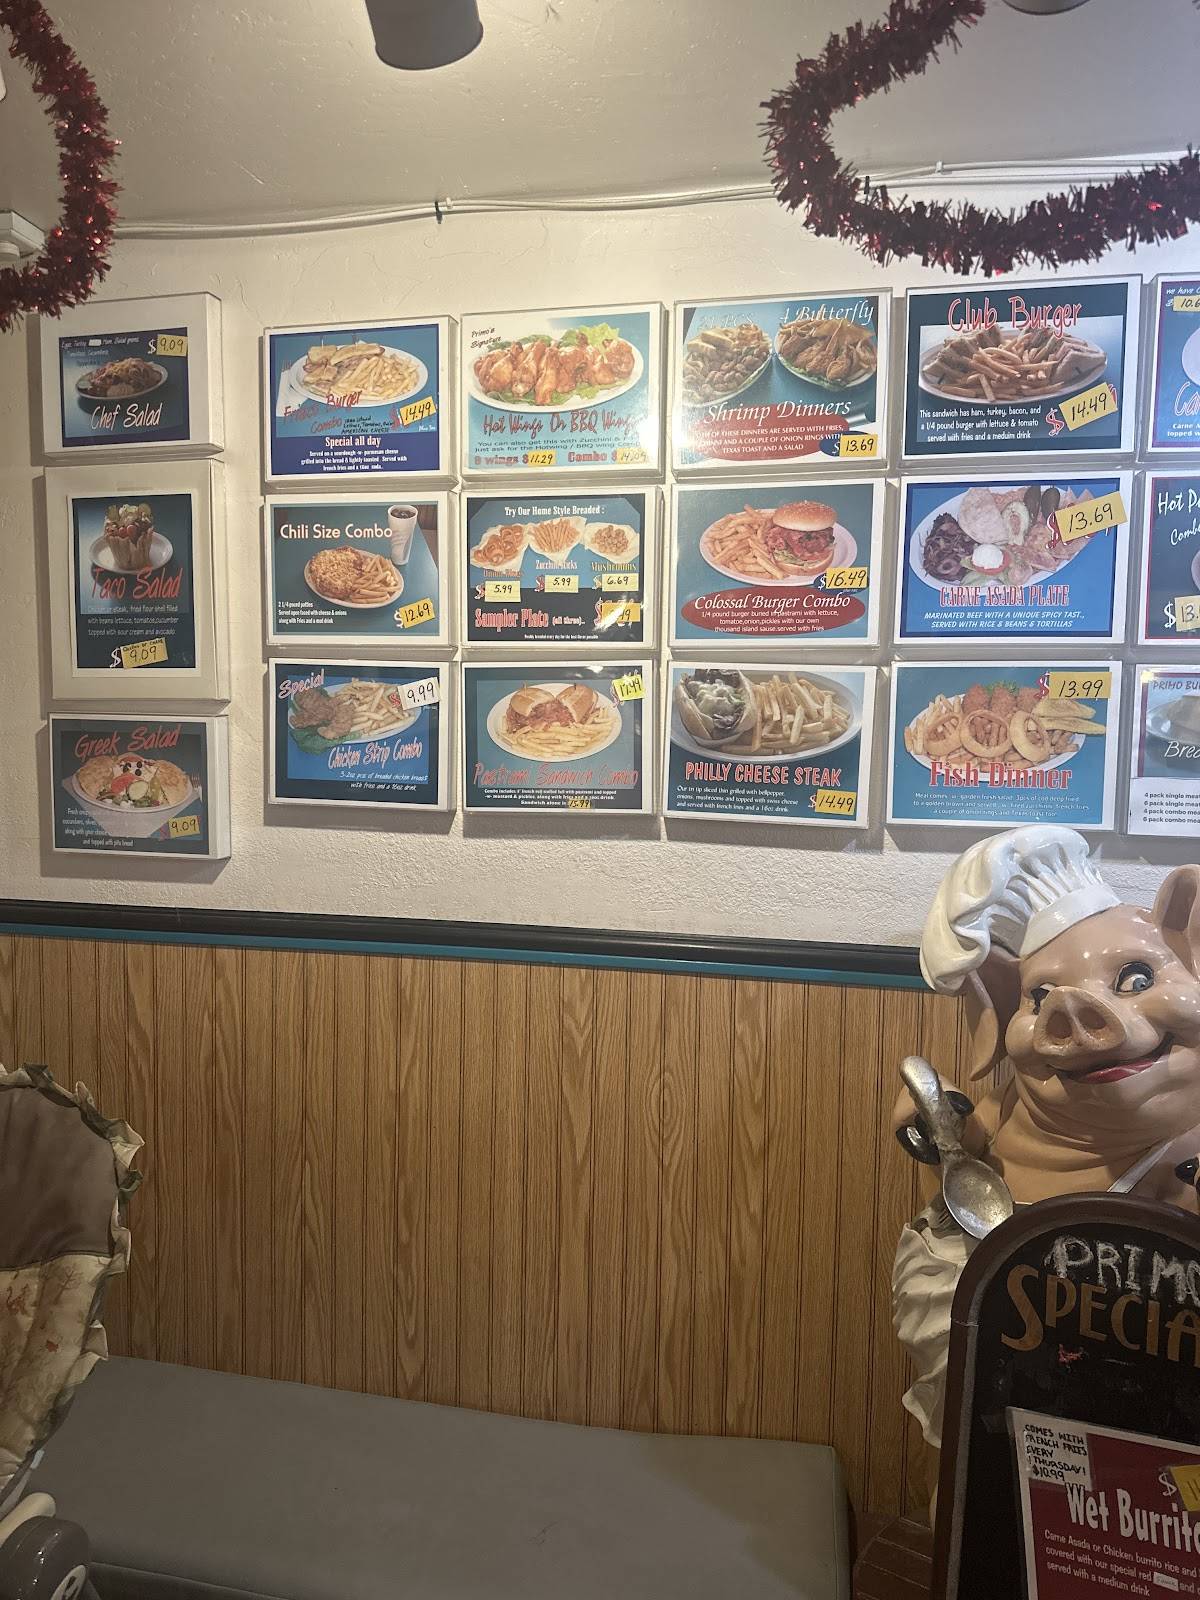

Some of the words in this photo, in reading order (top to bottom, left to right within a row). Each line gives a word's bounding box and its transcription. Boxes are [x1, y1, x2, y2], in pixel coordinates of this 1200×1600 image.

[796, 300, 874, 327] Butterfly
[948, 296, 998, 332] Club
[1008, 295, 1083, 339] Burger
[470, 336, 501, 348] Signature
[471, 328, 495, 338] Primo's
[161, 338, 184, 353] 9.09
[325, 390, 362, 411] Burger
[1071, 392, 1107, 421] 14.49
[91, 404, 121, 431] Chef
[123, 402, 163, 428] Salad
[405, 402, 431, 421] 14.49
[704, 401, 771, 426] Shrimp
[777, 401, 852, 418] Dinners
[920, 410, 931, 418] This
[932, 409, 959, 417] sandwich
[960, 408, 969, 416] has
[971, 408, 985, 416] ham,
[987, 407, 1006, 417] turkey,
[1009, 406, 1028, 415] bacon,
[1030, 405, 1041, 414] and
[483, 414, 506, 436] Hot
[509, 412, 543, 439] Wings
[551, 412, 567, 433] Or
[570, 410, 598, 433] BBQ
[937, 421, 954, 431] pound
[956, 421, 974, 431] burger
[976, 420, 987, 428] with
[989, 420, 1009, 428] lettuce
[1011, 419, 1016, 427] &
[325, 436, 353, 449] Special
[355, 436, 365, 446] all
[367, 436, 381, 448] day
[845, 438, 874, 452] 13.69
[928, 434, 946, 442] served
[948, 433, 959, 441] with
[961, 432, 974, 441] fries
[975, 432, 985, 440] and
[1017, 430, 1031, 439] drink
[485, 455, 518, 466] wings
[530, 454, 553, 464] 11.29
[568, 452, 607, 462] Combo
[505, 507, 516, 517] Try
[518, 507, 530, 515] Our
[532, 507, 551, 515] Home
[553, 506, 571, 516] Style
[572, 506, 600, 514] Breaded
[1158, 492, 1184, 516] Hot
[1069, 502, 1113, 533] 13.69
[280, 524, 308, 539] Chili
[313, 524, 340, 539] Size
[345, 523, 393, 538] Combo
[92, 568, 126, 599] Taco
[133, 566, 183, 599] Salad
[553, 578, 571, 586] 5.99
[607, 576, 628, 585] 6.69
[827, 570, 866, 587] 16.49
[494, 585, 512, 593] 5.99
[940, 585, 980, 607] CARNE
[984, 585, 1024, 607] ASADA
[1028, 585, 1070, 607] PLATE
[405, 603, 430, 622] 12.69
[694, 596, 748, 610] Colossal
[751, 596, 799, 614] Burger
[803, 594, 850, 608] Combo
[475, 608, 518, 632] Sampler
[521, 608, 549, 628] Plate
[1163, 601, 1176, 628] $
[130, 646, 157, 662] 9.09
[278, 668, 325, 699] Special
[407, 682, 435, 704] 9.99
[1058, 679, 1103, 698] 13.99
[1153, 680, 1183, 690] PRIMO
[75, 731, 120, 762] Greek
[128, 724, 182, 751] Salad
[328, 746, 361, 770] Chicken
[363, 742, 390, 768] Strip
[393, 737, 422, 760] Combo
[685, 762, 732, 781] PHILLY
[735, 765, 789, 785] CHEESE
[794, 767, 842, 787] STEAK
[929, 761, 980, 787] Fish
[988, 762, 1072, 790] Dinner
[818, 795, 853, 812] 14.49
[171, 819, 196, 832] 9.09
[1024, 1424, 1054, 1438] COMES
[1059, 1432, 1084, 1444] WITH
[1025, 1435, 1059, 1449] FRENCH
[1063, 1443, 1087, 1456] FRIES
[1026, 1445, 1054, 1458] EVERY
[1158, 1472, 1177, 1496] $
[1065, 1482, 1109, 1532] Wet
[1044, 1529, 1066, 1545] Carne
[1068, 1536, 1091, 1550] Asada
[1103, 1544, 1133, 1562] Chicken
[1135, 1552, 1162, 1568] burrito
[1165, 1562, 1179, 1573] rice
[1182, 1566, 1197, 1578] and
[1046, 1547, 1075, 1562] covered
[1077, 1553, 1093, 1566] with
[1095, 1559, 1108, 1569] our
[1110, 1561, 1136, 1578] special
[1139, 1569, 1151, 1582] red
[1180, 1582, 1195, 1594] and
[1047, 1562, 1071, 1575] served
[1073, 1567, 1090, 1579] with
[1092, 1573, 1096, 1581] a
[1098, 1575, 1129, 1590] medium
[1130, 1582, 1150, 1596] drink
